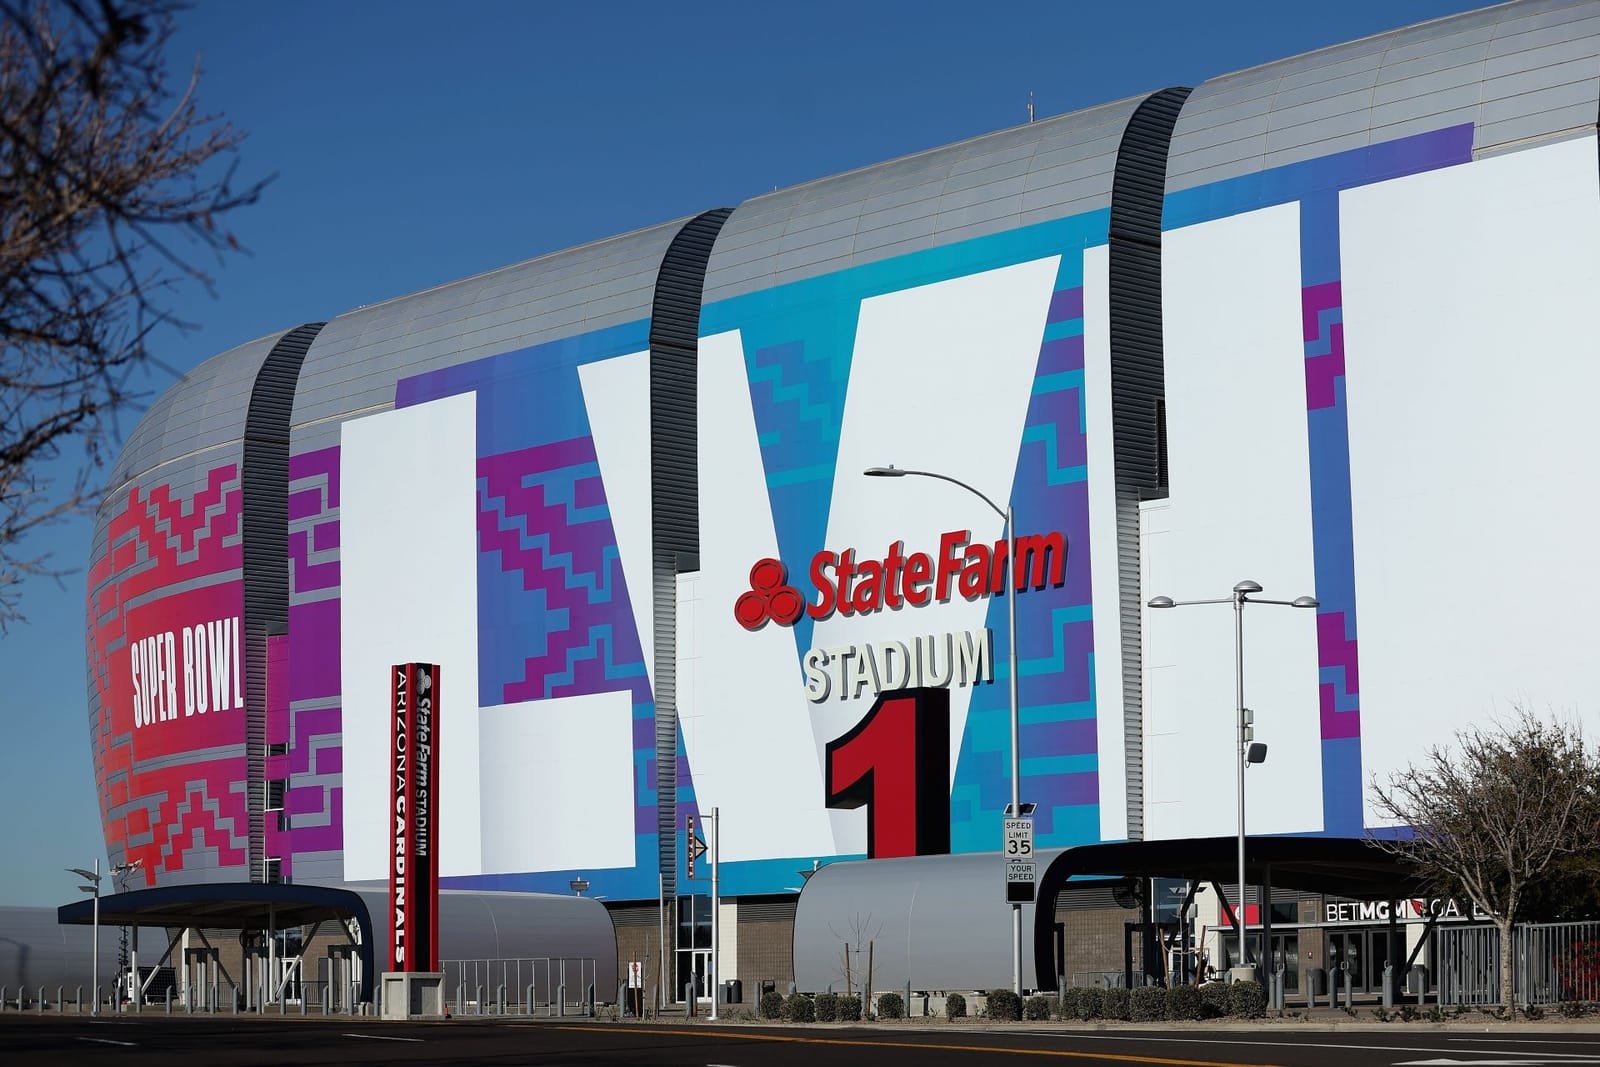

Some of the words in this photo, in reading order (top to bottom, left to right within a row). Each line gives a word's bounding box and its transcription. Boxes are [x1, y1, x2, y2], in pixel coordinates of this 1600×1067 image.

[131, 631, 178, 728] SUPER
[182, 617, 244, 717] BOWL
[803, 627, 994, 704] STADIUM
[396, 671, 407, 792] ARIZONA
[825, 687, 951, 859] 1
[415, 789, 427, 856] STADIUM
[1008, 840, 1031, 855] 35
[395, 795, 406, 963] CARDINALS
[1326, 900, 1407, 922] BETMGM
